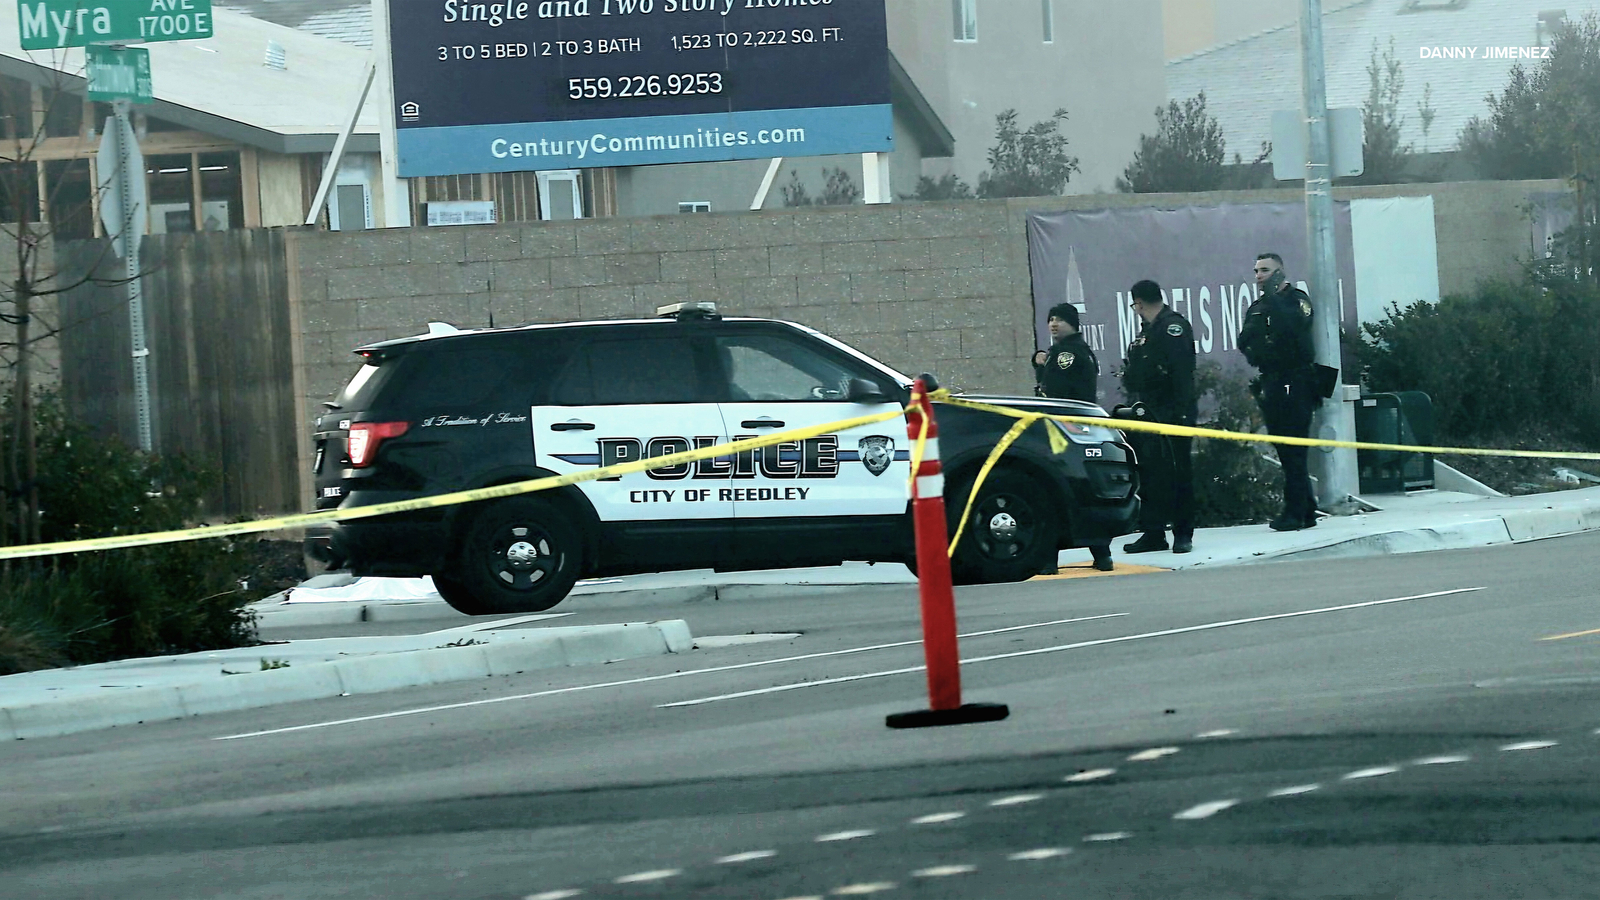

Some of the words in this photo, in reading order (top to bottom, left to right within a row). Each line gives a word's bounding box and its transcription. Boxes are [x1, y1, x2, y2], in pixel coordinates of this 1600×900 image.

[150, 0, 195, 12] AVE
[443, 0, 529, 27] Single
[537, 0, 591, 18] and
[21, 2, 111, 47] Myra
[138, 14, 191, 37] 1700
[195, 13, 210, 33] E
[437, 47, 448, 61] 3
[452, 45, 476, 60] TO
[480, 44, 491, 59] 5
[495, 43, 528, 58] BED
[541, 42, 552, 56] 2
[556, 41, 579, 56] TO
[582, 40, 593, 55] 3
[598, 37, 641, 54] BATH
[671, 34, 712, 52] 1,523
[715, 32, 738, 48] TO
[743, 30, 787, 48] 2,222
[791, 28, 818, 44] SQ.
[822, 27, 844, 42] FT.
[568, 71, 723, 100] 559.226.9253
[490, 126, 806, 160] CenturyCommunities.com
[1115, 285, 1214, 360] MLS
[1219, 281, 1264, 351] NO
[594, 434, 840, 482] POLICE
[1085, 448, 1102, 457] 679
[629, 489, 676, 504] CITY
[684, 488, 711, 503] OF
[718, 486, 811, 502] REEDLEY
